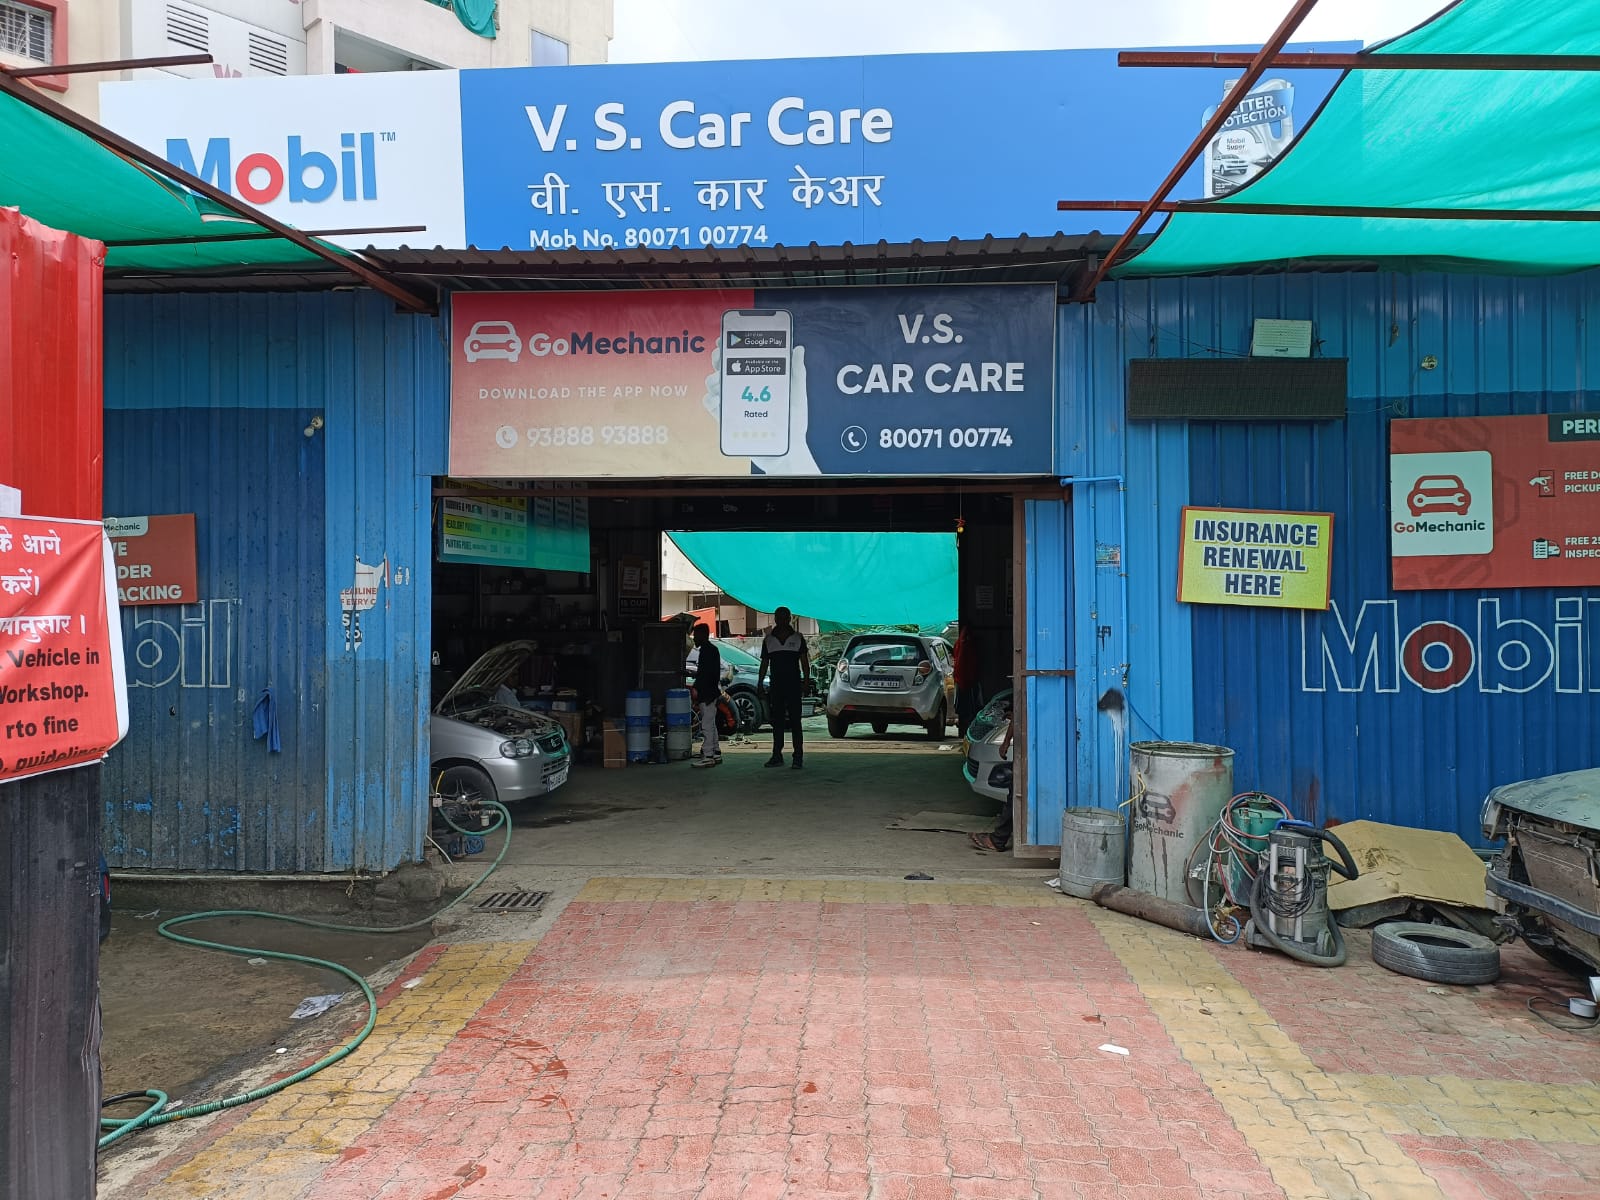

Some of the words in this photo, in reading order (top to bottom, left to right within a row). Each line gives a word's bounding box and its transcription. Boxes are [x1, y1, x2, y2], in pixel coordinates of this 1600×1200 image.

[525, 104, 577, 152] V.
[594, 102, 642, 150] S.
[659, 99, 751, 149] Car
[767, 96, 894, 146] Care
[1222, 105, 1287, 128] OTECTION
[166, 131, 377, 205] Mobil
[528, 172, 579, 216] वी.
[602, 182, 672, 218] एस.
[694, 179, 767, 211] कार
[788, 164, 885, 209] केअर
[529, 229, 577, 248] Mob
[583, 229, 619, 247] No.
[625, 227, 690, 247] 80071
[699, 225, 769, 245] 00774
[898, 313, 963, 344] V.S.
[528, 330, 706, 357] GoMechanic
[744, 337, 768, 346] Google
[769, 337, 782, 346] Play
[745, 366, 761, 374] App
[761, 365, 781, 373] Store
[836, 364, 914, 395] CAR
[924, 362, 1025, 394] CARE
[479, 387, 571, 400] DOWNLOAD
[578, 387, 606, 398] THE
[612, 386, 642, 398] APP
[650, 385, 688, 397] NOW
[741, 386, 772, 402] 4.6
[744, 410, 769, 418] Rated
[526, 427, 595, 448] 93888
[601, 425, 670, 446] 93888
[1562, 418, 1600, 435] PER
[879, 429, 943, 448] 80071
[949, 428, 1013, 448] 00774
[1564, 471, 1589, 480] FREE
[103, 522, 141, 532] Mechanic
[1194, 519, 1318, 546] INSURANCE
[1393, 520, 1486, 534] GoMechanic
[22, 529, 61, 555] आगे
[1565, 537, 1590, 545] FREE
[1203, 546, 1306, 571] RENEWAL
[118, 564, 152, 579] DER
[118, 584, 182, 601] ACKING
[1225, 573, 1282, 596] HERE
[6, 647, 81, 668] Vehicle
[86, 647, 100, 664] in
[43, 715, 79, 735] fine
